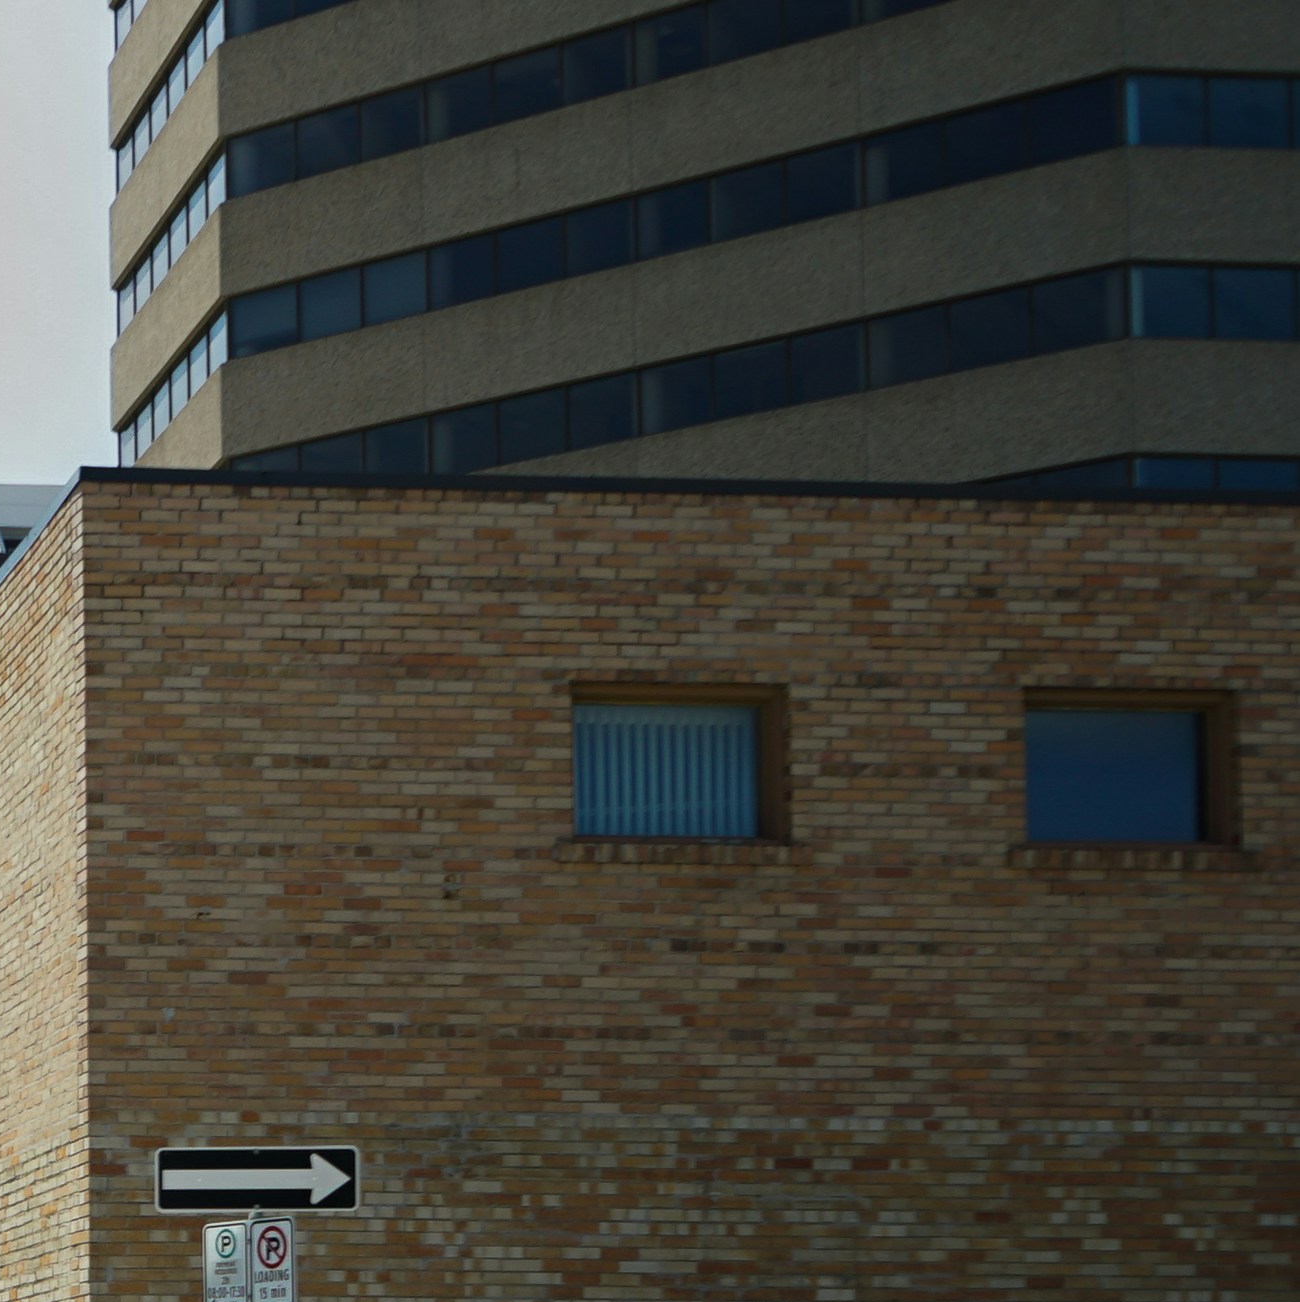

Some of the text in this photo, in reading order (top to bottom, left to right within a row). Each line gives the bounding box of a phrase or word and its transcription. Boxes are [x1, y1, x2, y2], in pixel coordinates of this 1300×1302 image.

[254, 1270, 289, 1284] LOADING
[259, 1285, 286, 1300] 15 min
